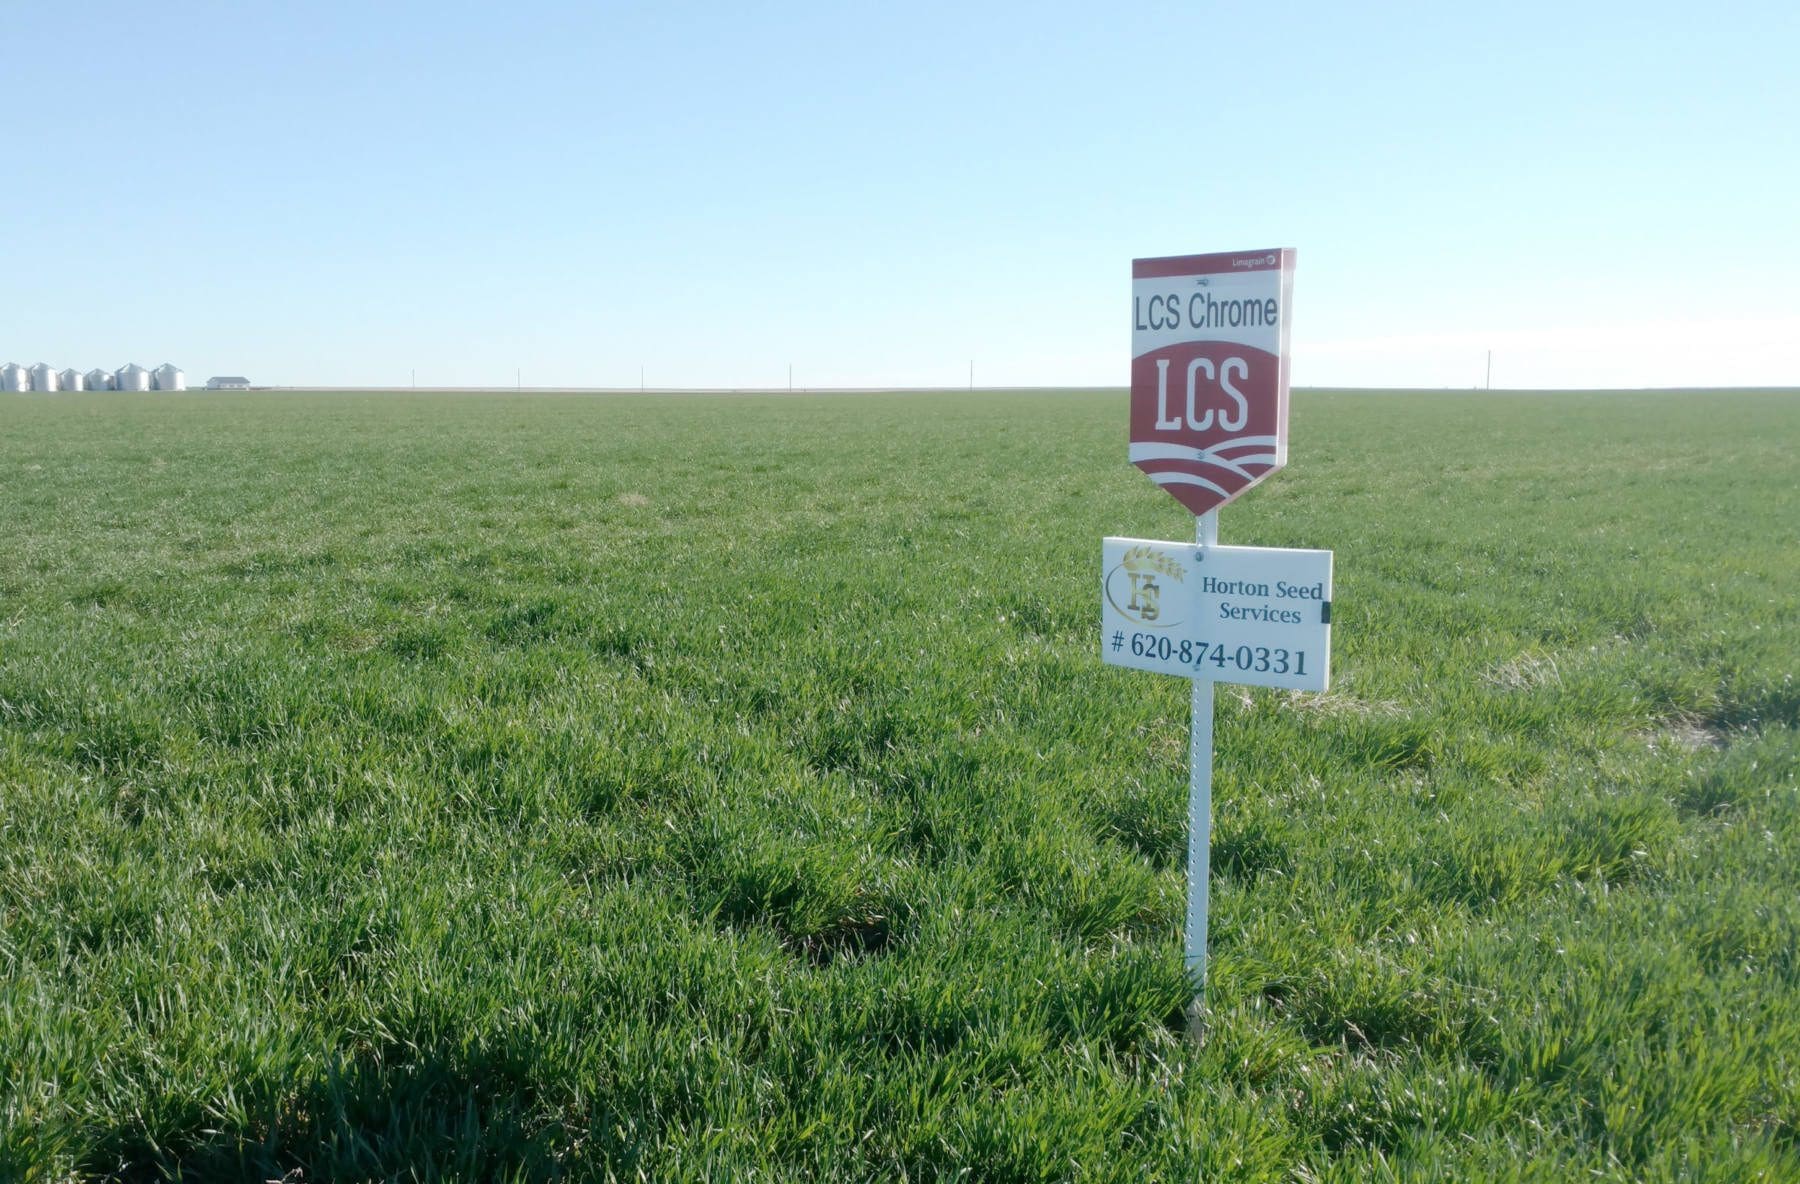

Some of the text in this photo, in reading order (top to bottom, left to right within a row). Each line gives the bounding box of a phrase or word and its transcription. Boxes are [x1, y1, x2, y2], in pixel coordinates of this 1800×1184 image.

[1232, 257, 1265, 267] Limagrain
[1135, 292, 1278, 331] LCS Chrome
[1155, 357, 1249, 432] LCS
[1202, 576, 1323, 600] Horton Seed
[1219, 602, 1302, 624] Services
[1111, 630, 1308, 676] # 620-874-0331
